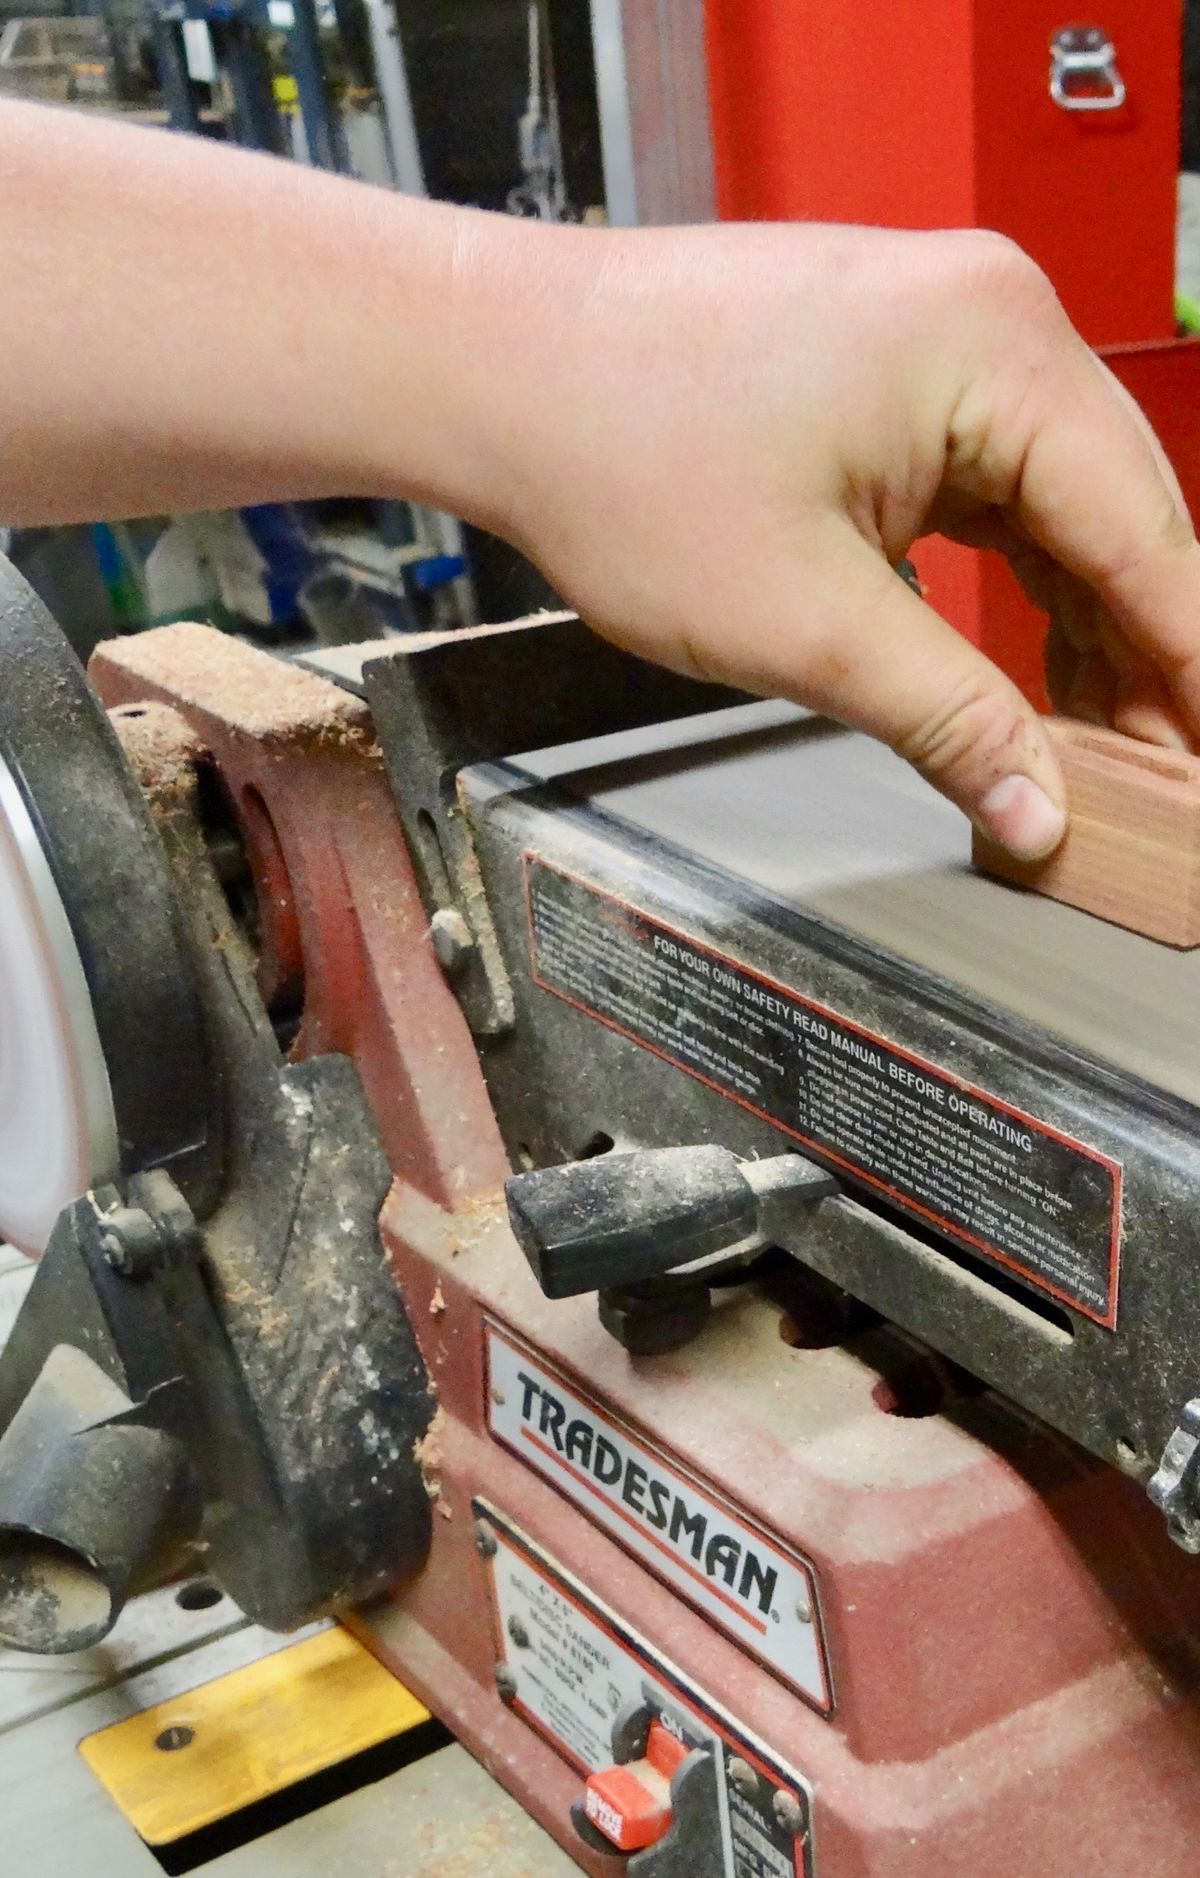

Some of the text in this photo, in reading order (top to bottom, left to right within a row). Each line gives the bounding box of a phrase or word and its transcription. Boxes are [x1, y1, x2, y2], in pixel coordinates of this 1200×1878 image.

[653, 935, 678, 961] FOR
[678, 947, 711, 979] YOUR
[712, 963, 741, 994] OWN
[743, 983, 791, 1019] SAFETY
[792, 1008, 827, 1042] READ
[830, 1029, 885, 1074] MANUAL
[888, 1060, 945, 1106] BEFORE
[947, 1092, 1032, 1154] OPERATING
[804, 1036, 831, 1061] Secure
[831, 1052, 847, 1070] tool
[847, 1061, 880, 1091] properly
[880, 1080, 890, 1094] to
[890, 1086, 920, 1113] prevent
[805, 1052, 832, 1077] Always
[833, 1068, 843, 1082] be
[844, 1074, 861, 1092] sure
[862, 1084, 895, 1111] machine
[896, 1103, 904, 1116] is
[904, 1107, 939, 1138] adjusted
[940, 1128, 956, 1146] and
[957, 1138, 968, 1152] all
[993, 1159, 1007, 1174] are
[1008, 1166, 1017, 1180] in
[1019, 1172, 1043, 1196] place
[1043, 1186, 1072, 1211] before
[809, 1093, 820, 1108] Do
[821, 1100, 834, 1116] not
[854, 1119, 872, 1138] dust
[896, 1143, 906, 1160] by
[931, 1164, 961, 1193] Unplug
[980, 1192, 1008, 1217] before
[1009, 1210, 1025, 1230] any
[809, 1106, 821, 1121] Do
[822, 1114, 834, 1129] not
[835, 1122, 865, 1149] operate
[865, 1139, 886, 1160] while
[887, 1152, 909, 1173] under
[910, 1165, 924, 1182] the
[924, 1173, 962, 1205] influence
[963, 1196, 973, 1211] of
[1003, 1219, 1034, 1247] alcohol
[1036, 1240, 1045, 1254] or
[849, 1091, 873, 1115] power
[895, 1117, 916, 1137] Clear
[917, 1129, 939, 1150] Table
[939, 1142, 955, 1160] and
[976, 1162, 1003, 1187] before
[1004, 1178, 1036, 1208] turning
[862, 1111, 871, 1124] to
[889, 1127, 897, 1139] or
[899, 1133, 912, 1148] use
[915, 1141, 923, 1154] in
[836, 1135, 845, 1149] to
[845, 1140, 872, 1167] comply
[874, 1157, 891, 1176] with
[891, 1168, 913, 1189] these
[914, 1182, 951, 1215] warnings
[952, 1205, 969, 1225] may
[971, 1215, 995, 1239] result
[996, 1231, 1005, 1244] in
[1006, 1237, 1039, 1265] serious
[1040, 1257, 1077, 1290] personal
[517, 1371, 778, 1615] TRADESMAN
[660, 1712, 683, 1741] ON
